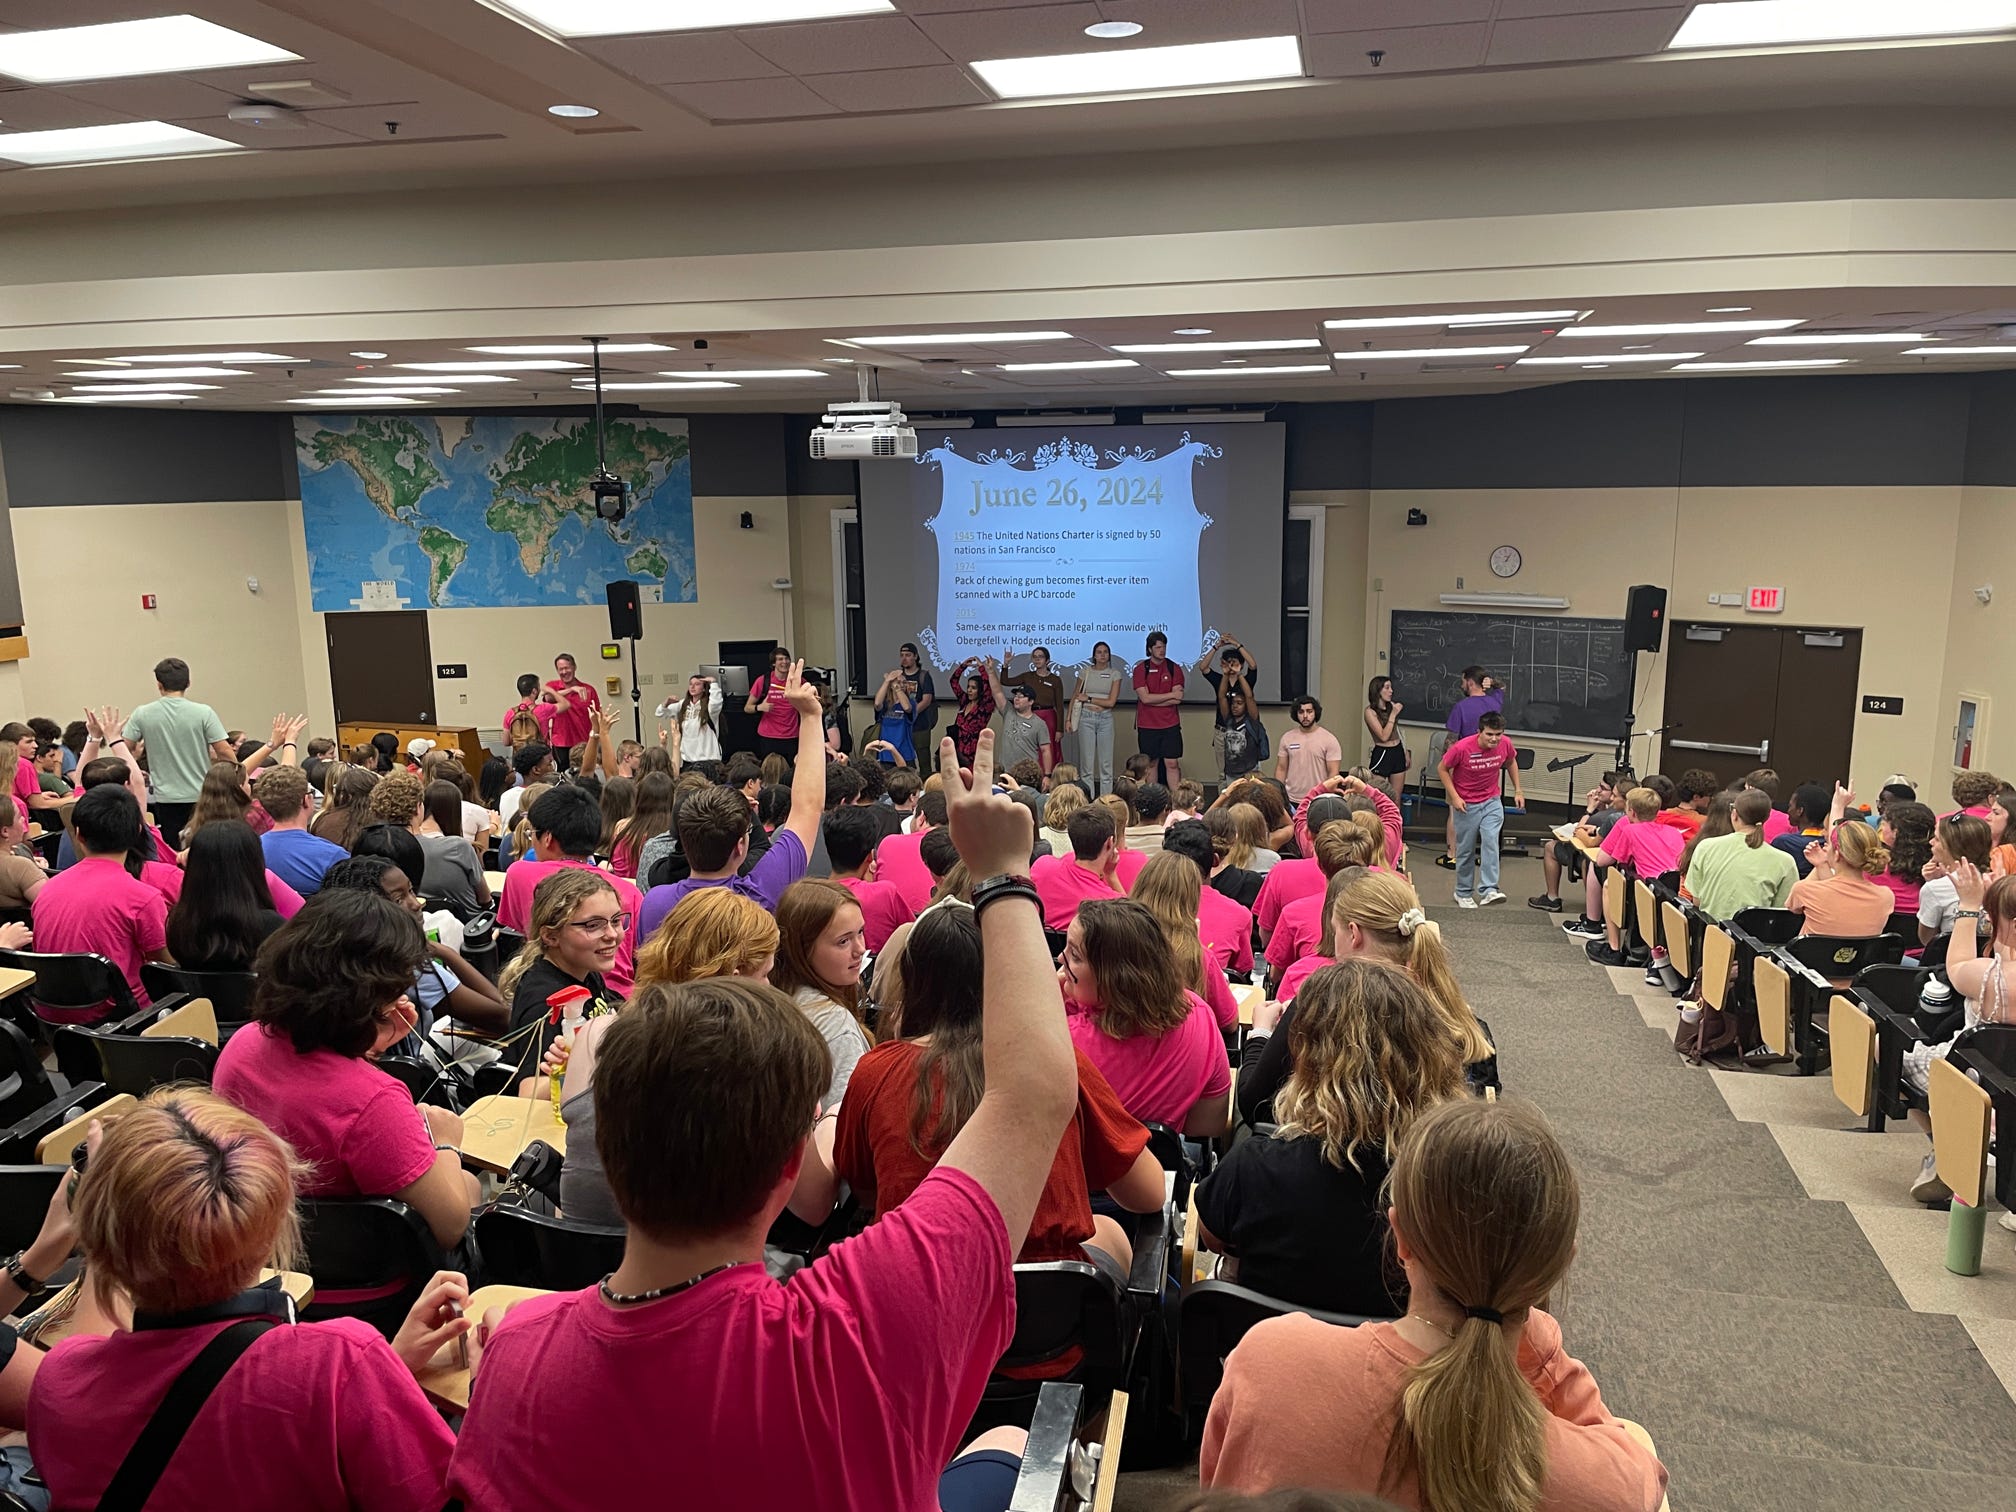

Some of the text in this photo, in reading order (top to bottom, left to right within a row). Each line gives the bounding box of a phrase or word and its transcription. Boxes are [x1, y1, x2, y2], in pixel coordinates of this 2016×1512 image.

[968, 476, 1164, 516] June 26, 2024
[954, 529, 1161, 542] 1945 The United Nations Charter is signed by 50
[954, 544, 1056, 555] nations in San Francisco
[955, 562, 976, 572] 1974
[955, 575, 1150, 587] Pack of chewing gum becomes first-ever item
[955, 589, 1076, 599] scanned with a UPC barcode
[1751, 588, 1779, 608] EXIT
[956, 622, 1169, 633] Same-sex marriage is made legal nationwide with
[956, 635, 1000, 647] Obergefell
[1011, 635, 1043, 647] Hodges
[1044, 635, 1080, 646] decision
[1869, 700, 1887, 709] 124
